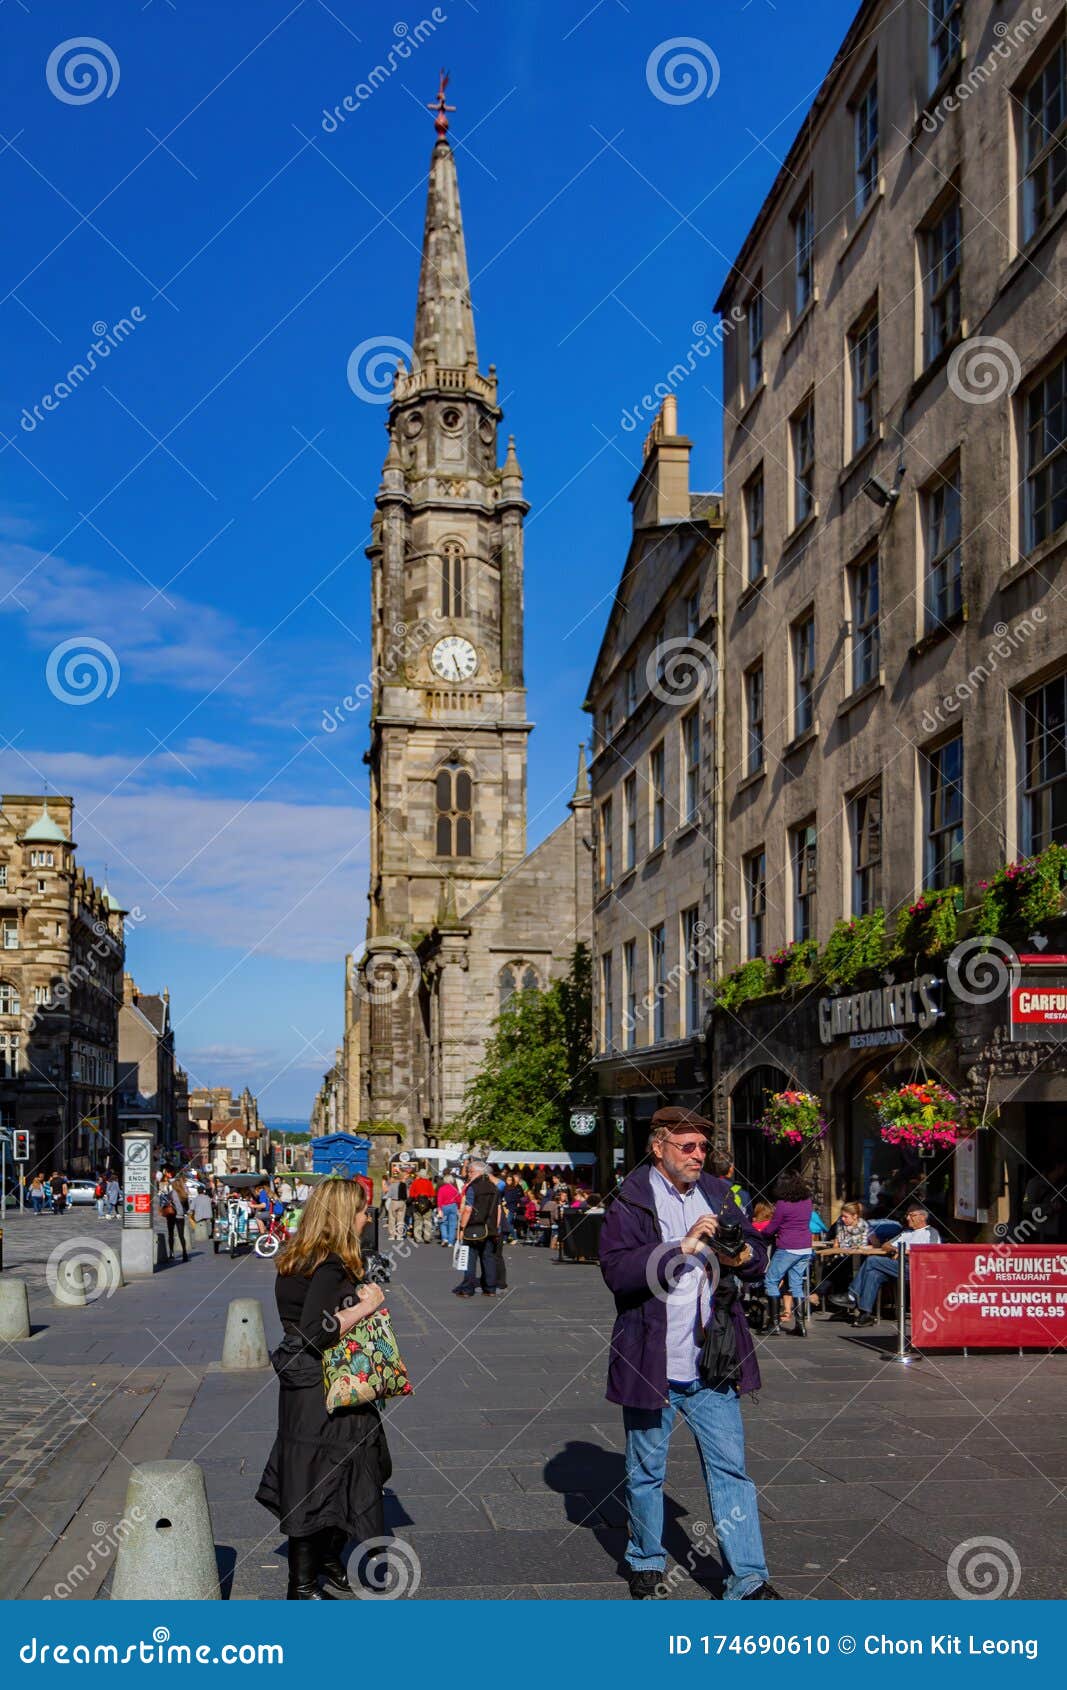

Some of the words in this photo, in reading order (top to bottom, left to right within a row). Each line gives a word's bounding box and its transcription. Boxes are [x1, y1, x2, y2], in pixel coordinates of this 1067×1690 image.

[1019, 992, 1067, 1014] GARFU
[850, 1029, 905, 1049] RESTAURANT
[975, 1255, 1067, 1276] GARFUNKEL'S
[995, 1273, 1051, 1281] RESTAURANT
[947, 1292, 998, 1304] GREAT
[1002, 1292, 1052, 1304] LUNCH
[981, 1306, 1023, 1318] FROM
[1026, 1306, 1065, 1318] £6.95
